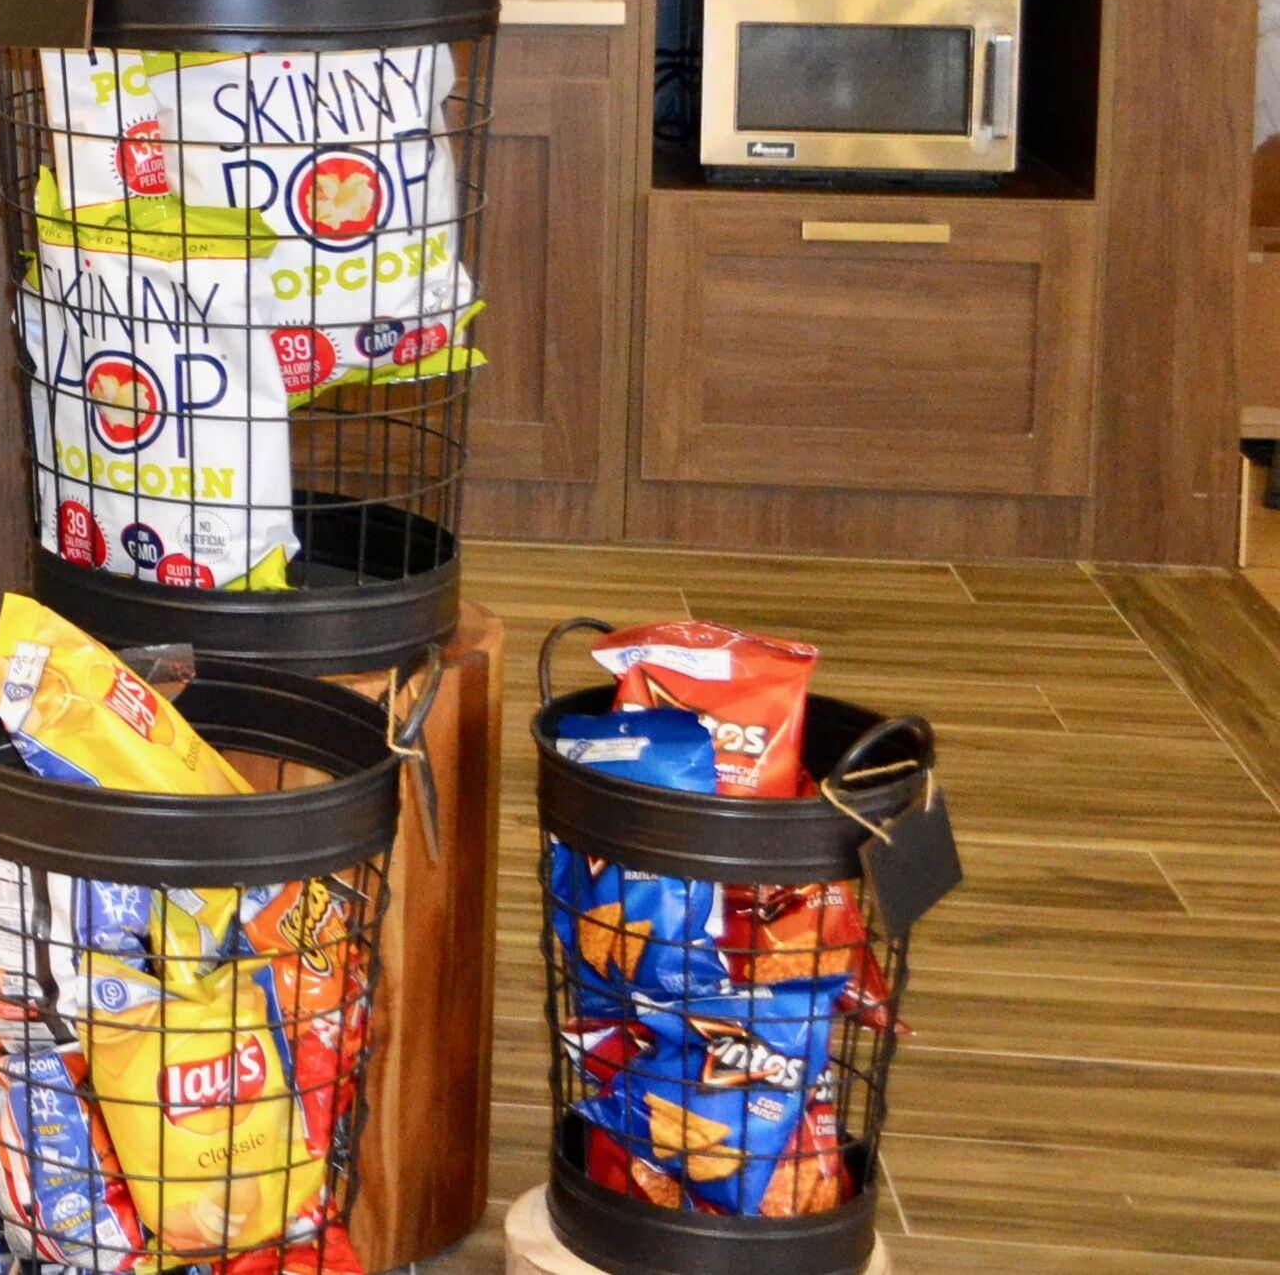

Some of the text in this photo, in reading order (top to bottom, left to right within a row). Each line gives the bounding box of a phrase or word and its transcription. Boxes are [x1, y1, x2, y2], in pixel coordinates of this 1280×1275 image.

[214, 48, 423, 152] SKINNY
[271, 231, 451, 303] OPCORN
[278, 333, 311, 363] 39
[279, 361, 320, 375] CALORIS
[67, 508, 87, 538] 39
[199, 521, 211, 533] NO
[184, 533, 226, 547] ATIFICIAL
[166, 563, 201, 577] GLUTN
[8, 1055, 60, 1073] PECOIN
[164, 1041, 262, 1115] Lay's
[197, 1131, 268, 1170] Classic
